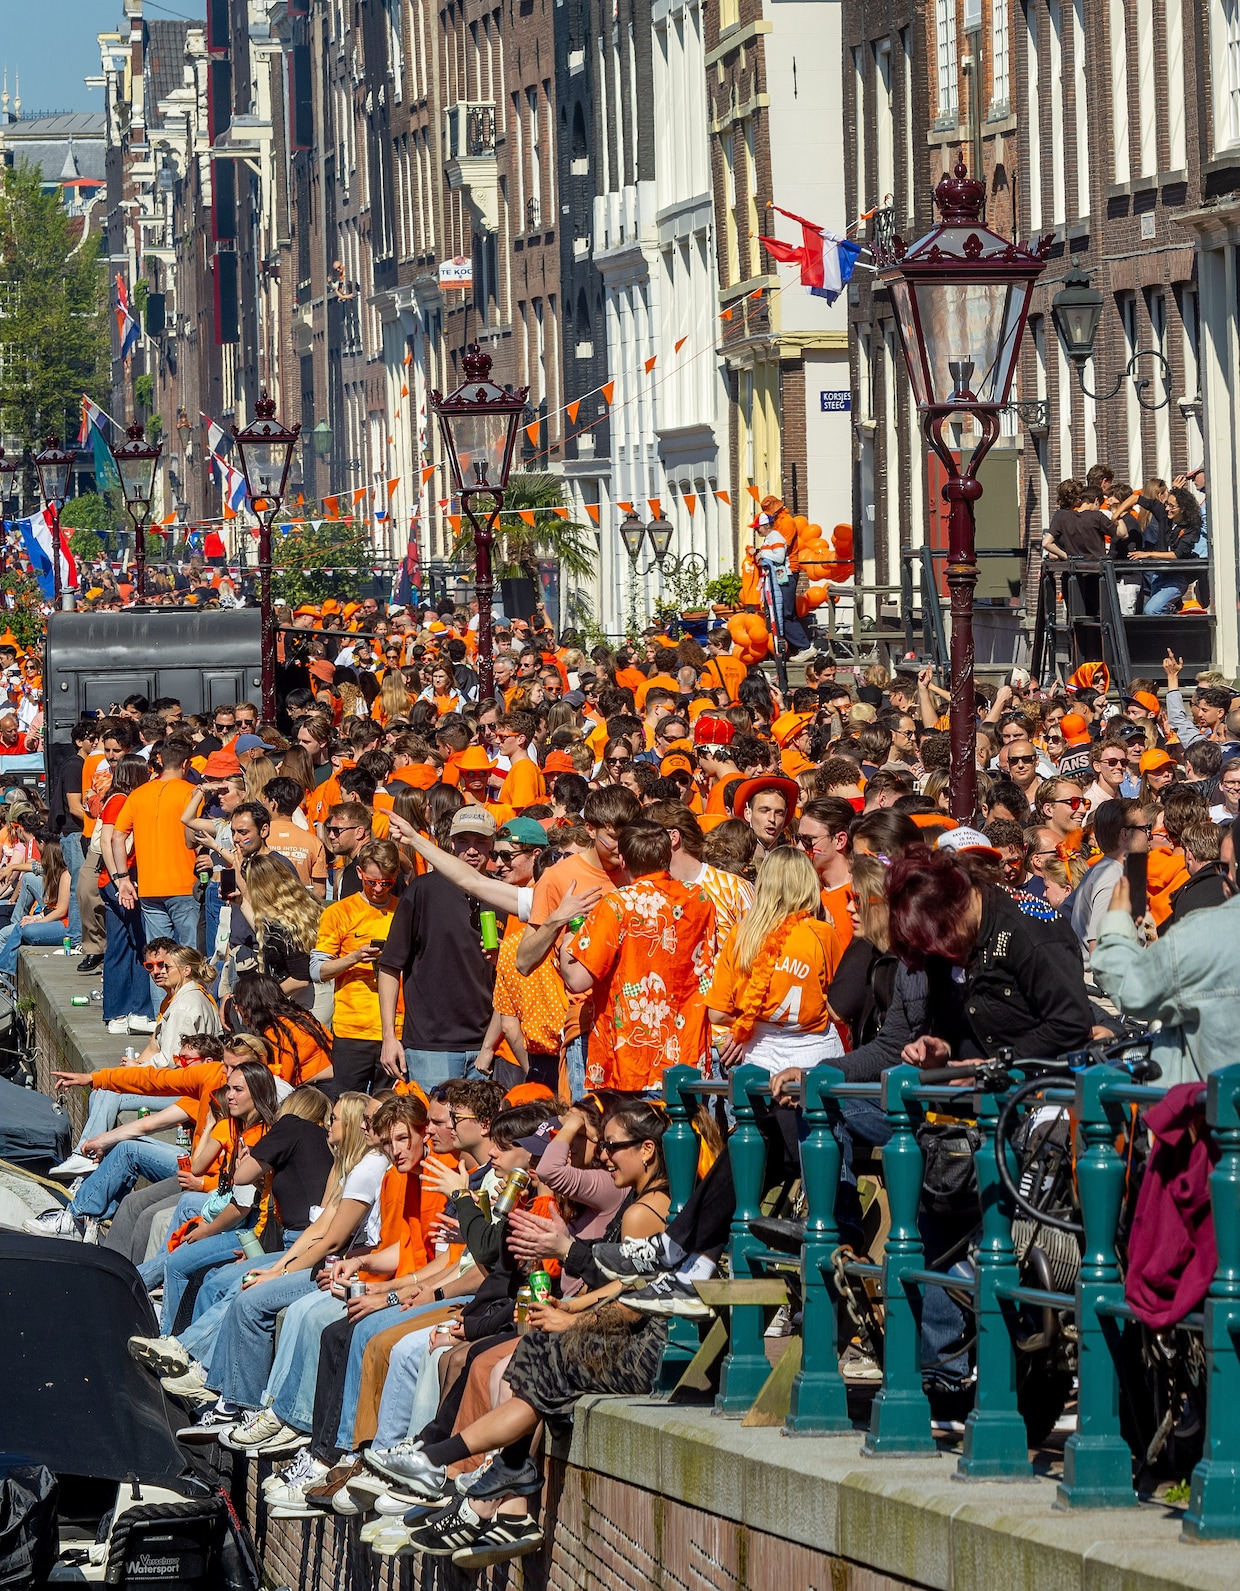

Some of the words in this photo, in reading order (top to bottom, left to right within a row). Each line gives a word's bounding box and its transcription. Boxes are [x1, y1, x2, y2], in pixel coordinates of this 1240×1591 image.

[823, 392, 852, 402] KORSJES
[823, 401, 845, 410] STEEG
[1057, 750, 1090, 774] VANS
[140, 1554, 180, 1567] Verschuur
[124, 1561, 180, 1575] Watersport
